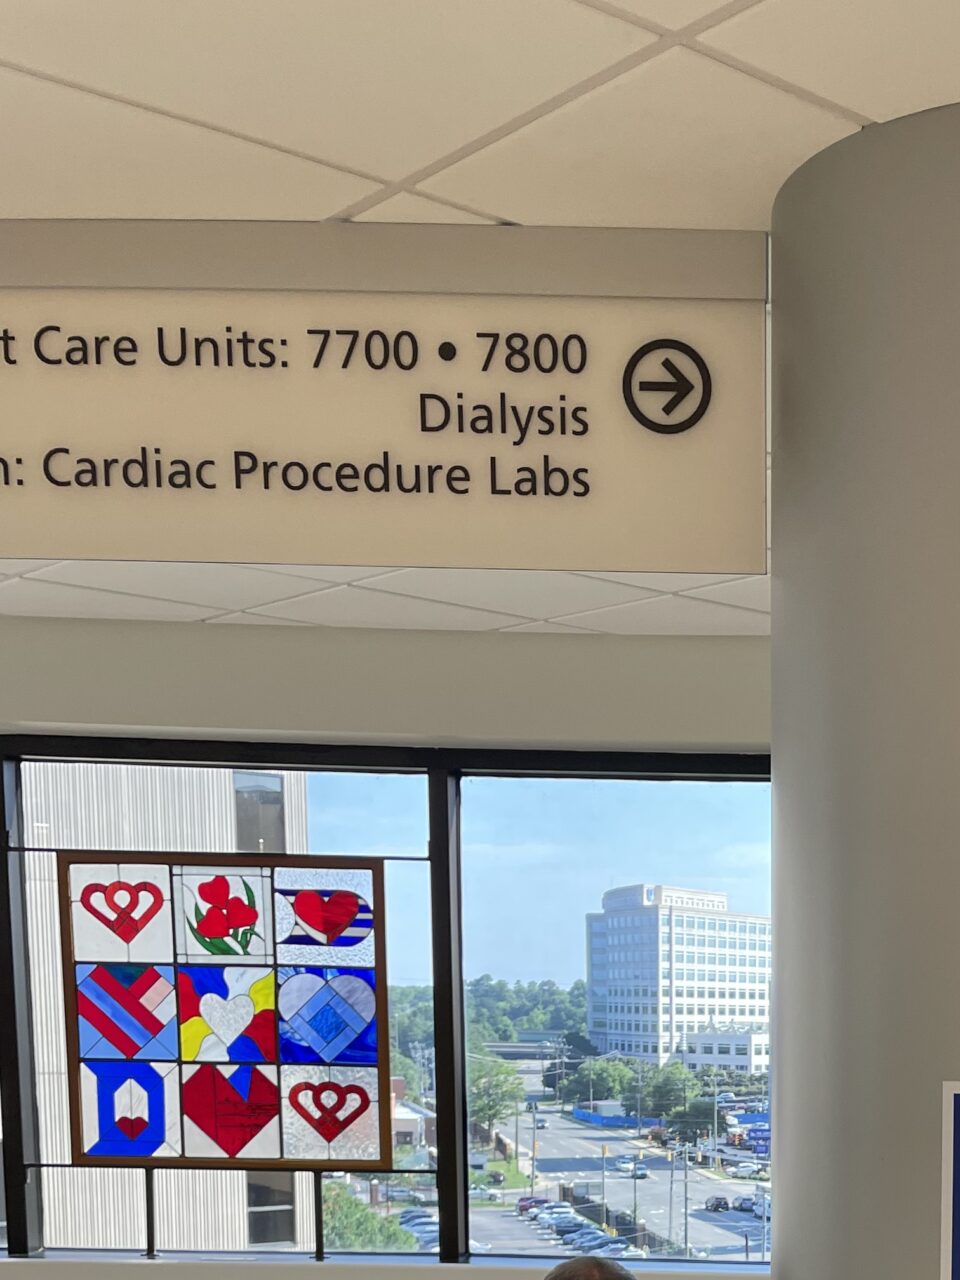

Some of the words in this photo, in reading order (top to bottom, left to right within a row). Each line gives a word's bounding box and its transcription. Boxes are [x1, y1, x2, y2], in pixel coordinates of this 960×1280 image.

[33, 325, 138, 367] Care
[157, 326, 289, 369] Units:
[306, 329, 419, 371] 7700
[476, 332, 588, 375] 7800
[419, 392, 589, 447] Dialysis
[42, 446, 217, 490] Cardiac
[233, 450, 471, 495] Procedure
[489, 454, 590, 498] Labs
